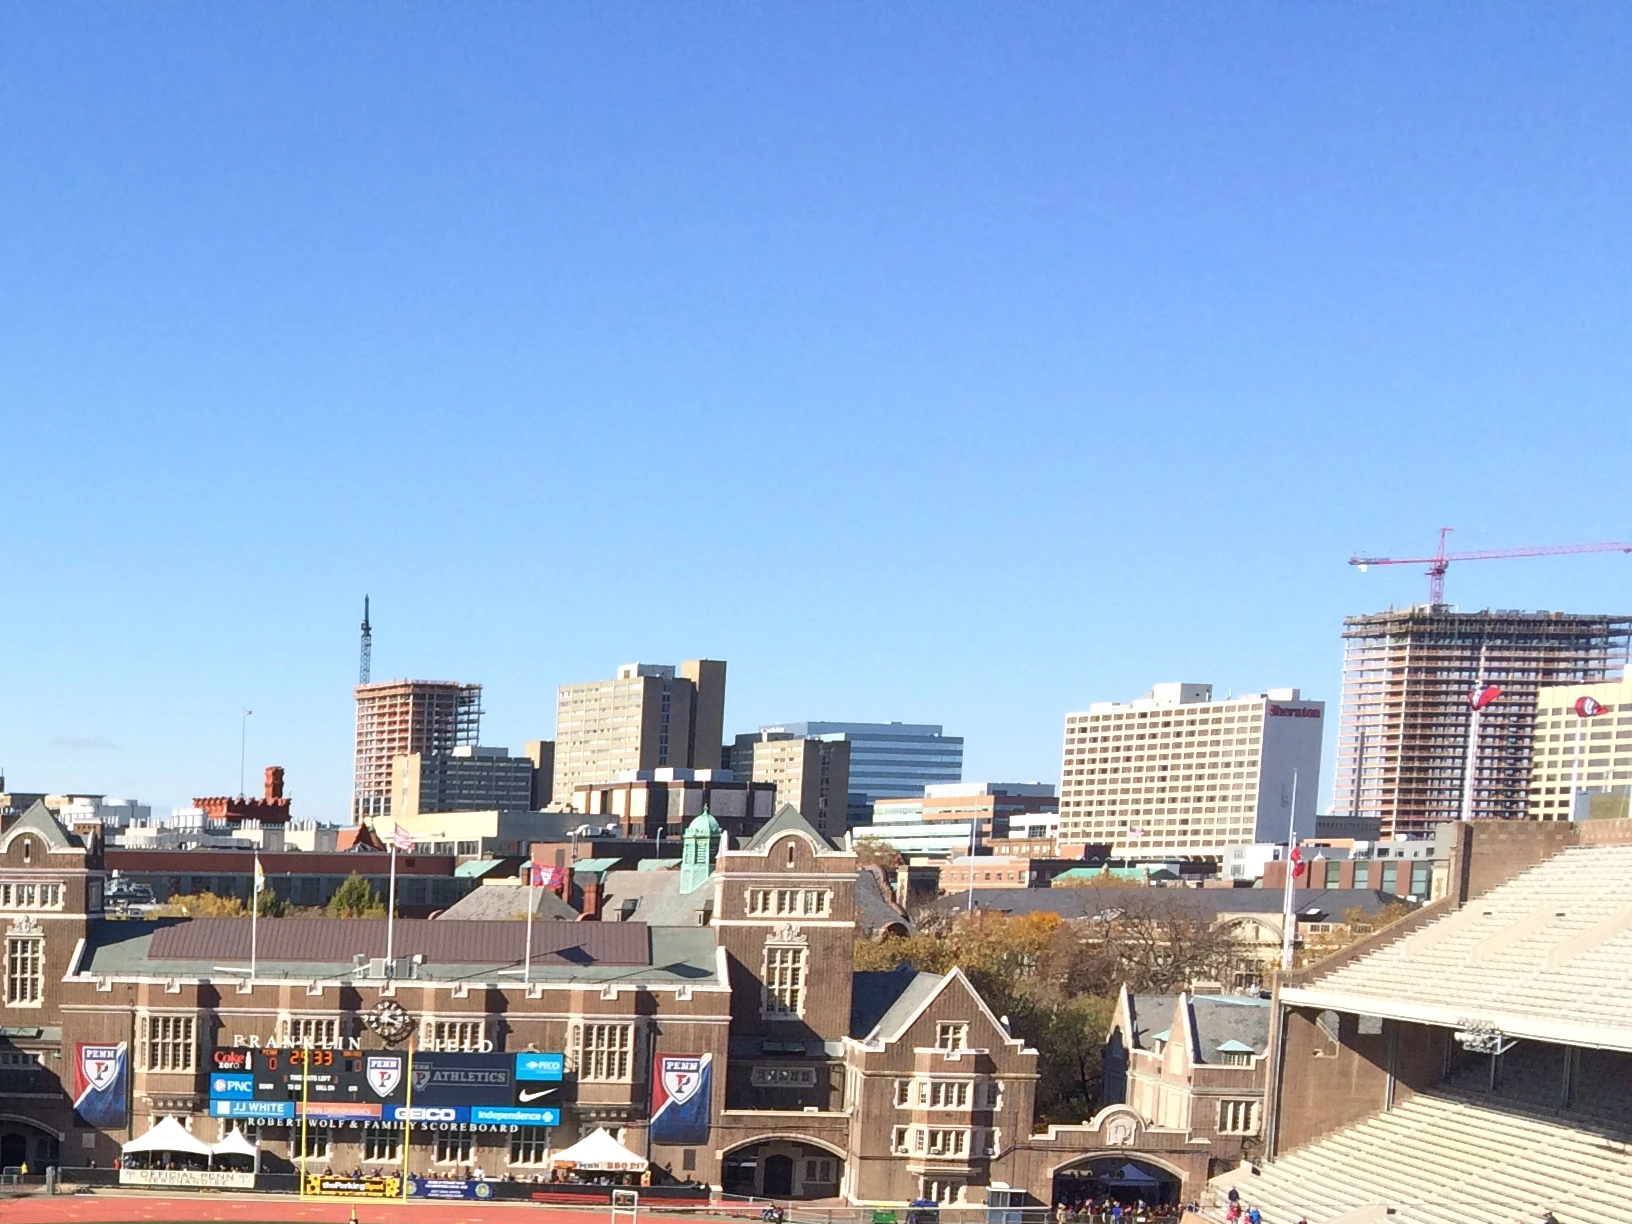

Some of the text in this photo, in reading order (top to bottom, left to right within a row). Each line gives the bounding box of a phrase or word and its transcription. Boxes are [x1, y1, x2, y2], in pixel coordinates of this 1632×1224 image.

[234, 1035, 362, 1050] FRANKLIN
[86, 1050, 115, 1058] PENN
[214, 1051, 245, 1063] Coke
[370, 1060, 397, 1068] PENN
[538, 1061, 560, 1070] PECO
[667, 1061, 698, 1070] PENN
[433, 1070, 506, 1082] ATHLETICS
[227, 1081, 252, 1092] PNC
[249, 1102, 284, 1113] WHITE
[394, 1107, 455, 1121] GEICO
[478, 1110, 541, 1121] Independence
[248, 1117, 519, 1133] ROBERT WOLF & FAMILY SCOREBOARD
[141, 1171, 234, 1181] OFFICIAL PENN
